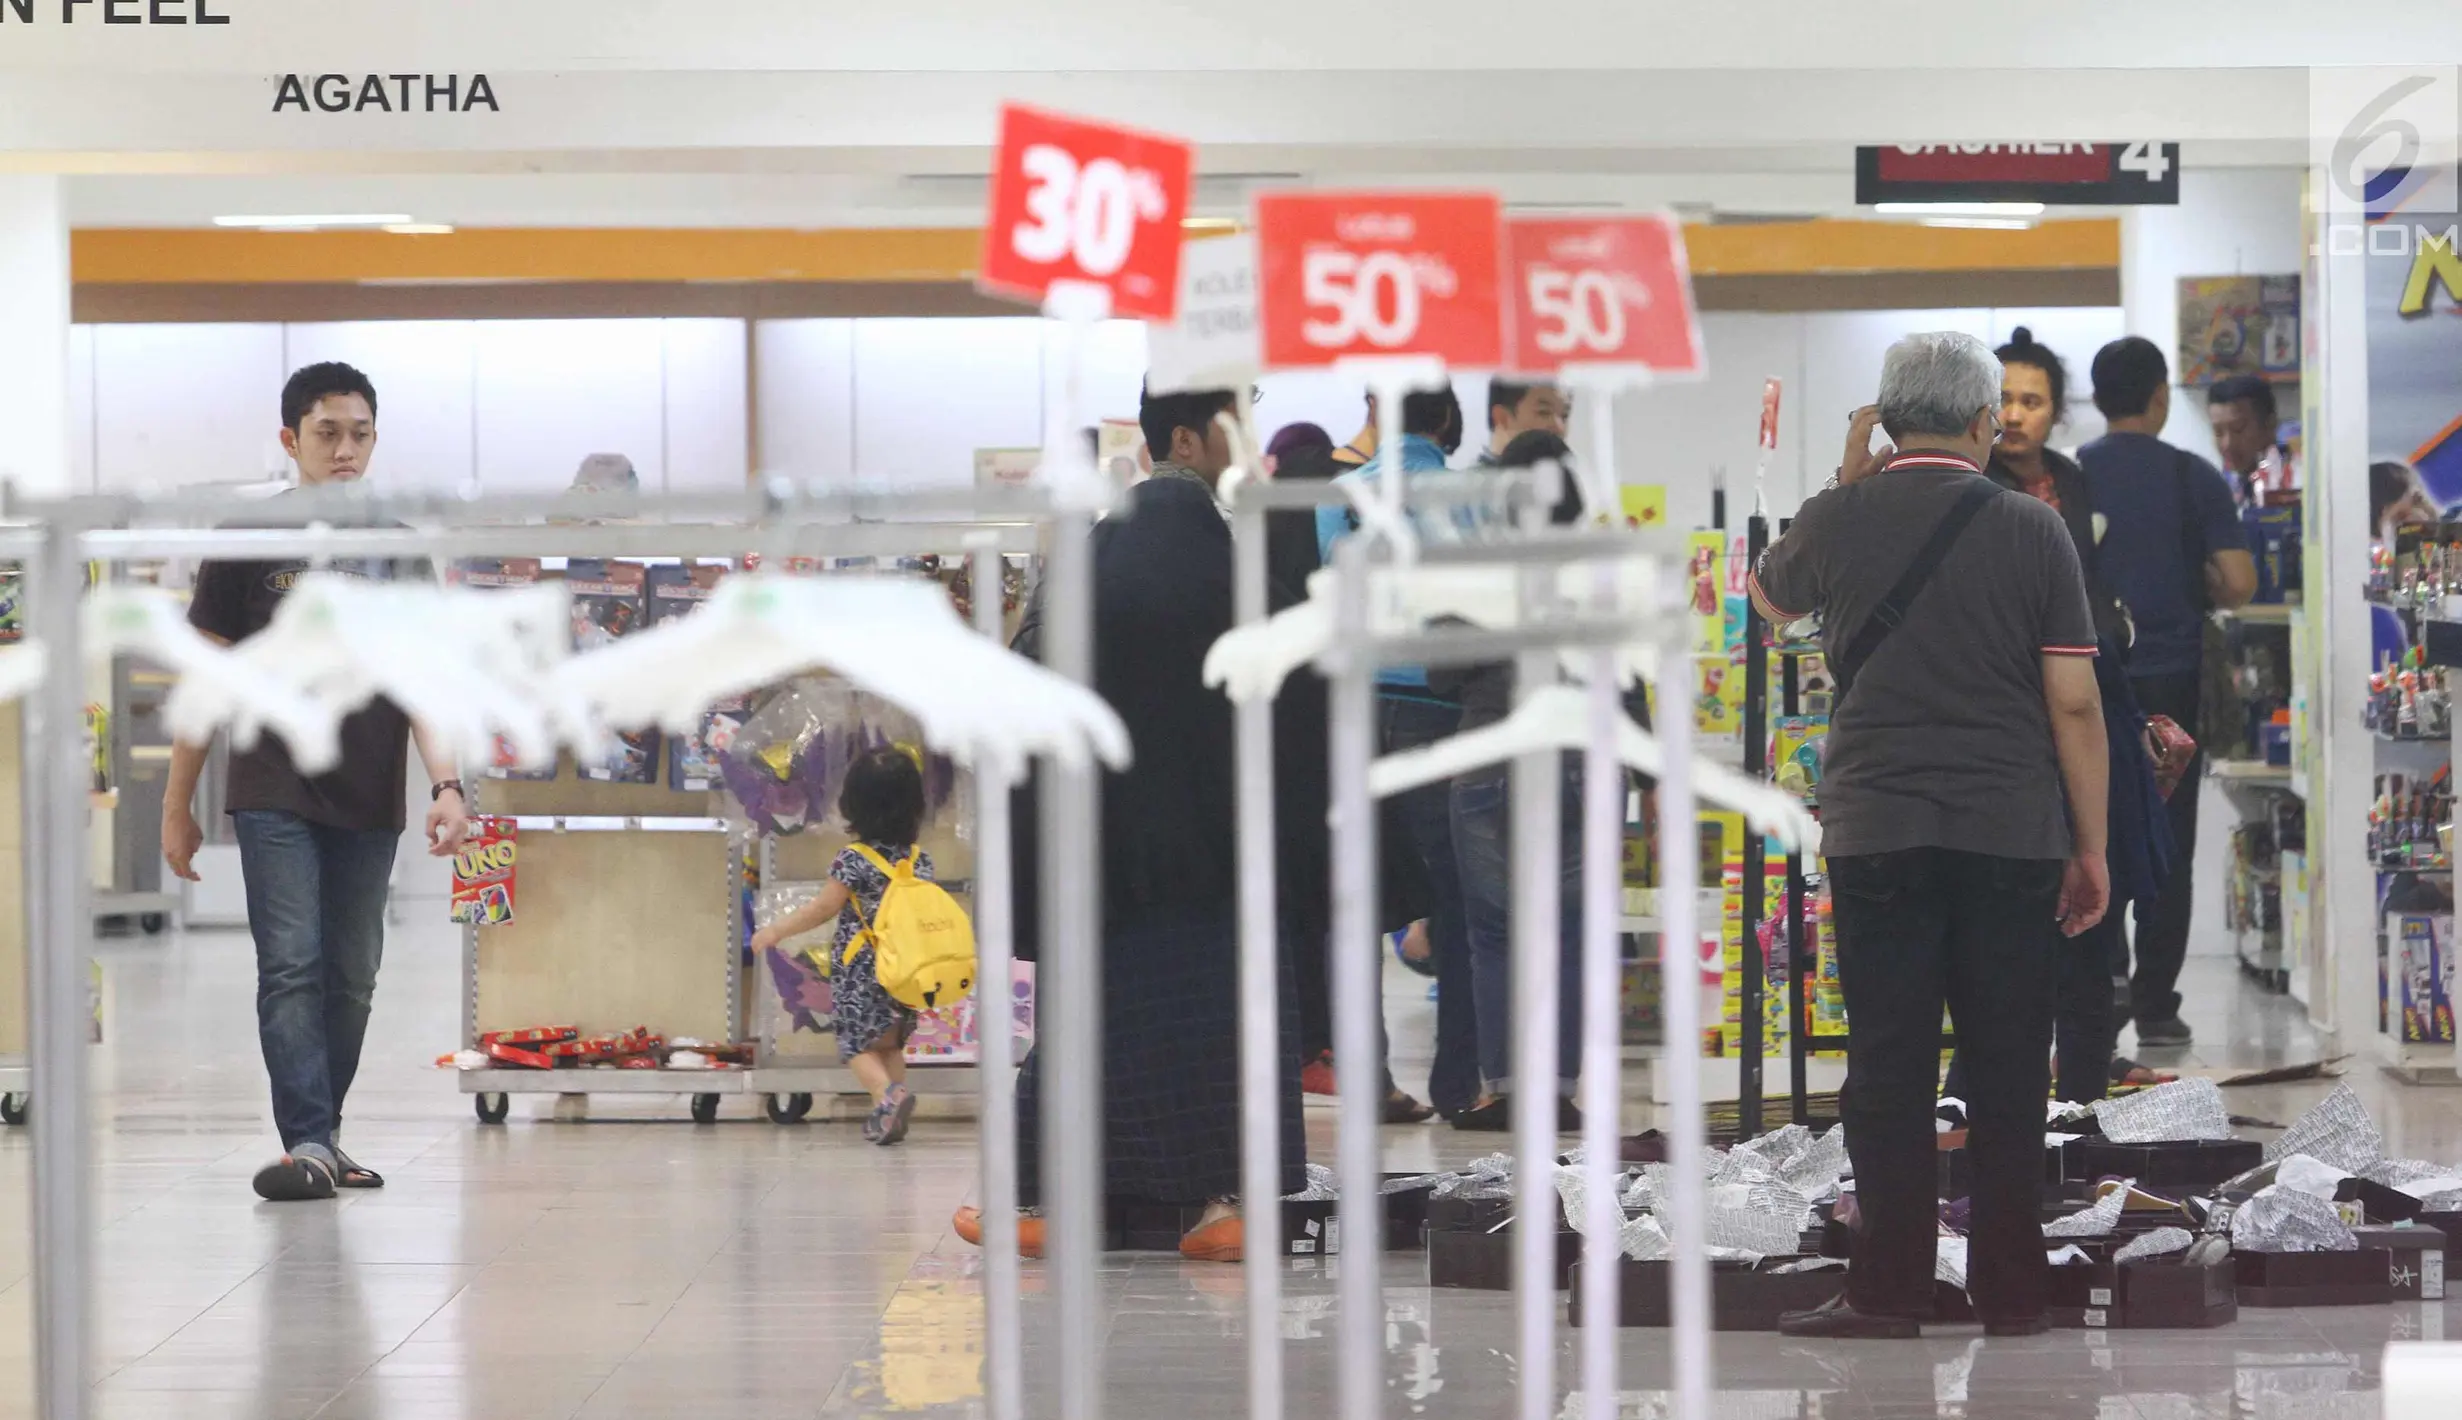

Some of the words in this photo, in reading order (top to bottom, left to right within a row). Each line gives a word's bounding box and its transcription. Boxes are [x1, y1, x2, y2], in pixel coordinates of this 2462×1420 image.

[272, 74, 500, 112] AGATHA
[2119, 141, 2169, 182] 4
[454, 839, 517, 880] UNO
